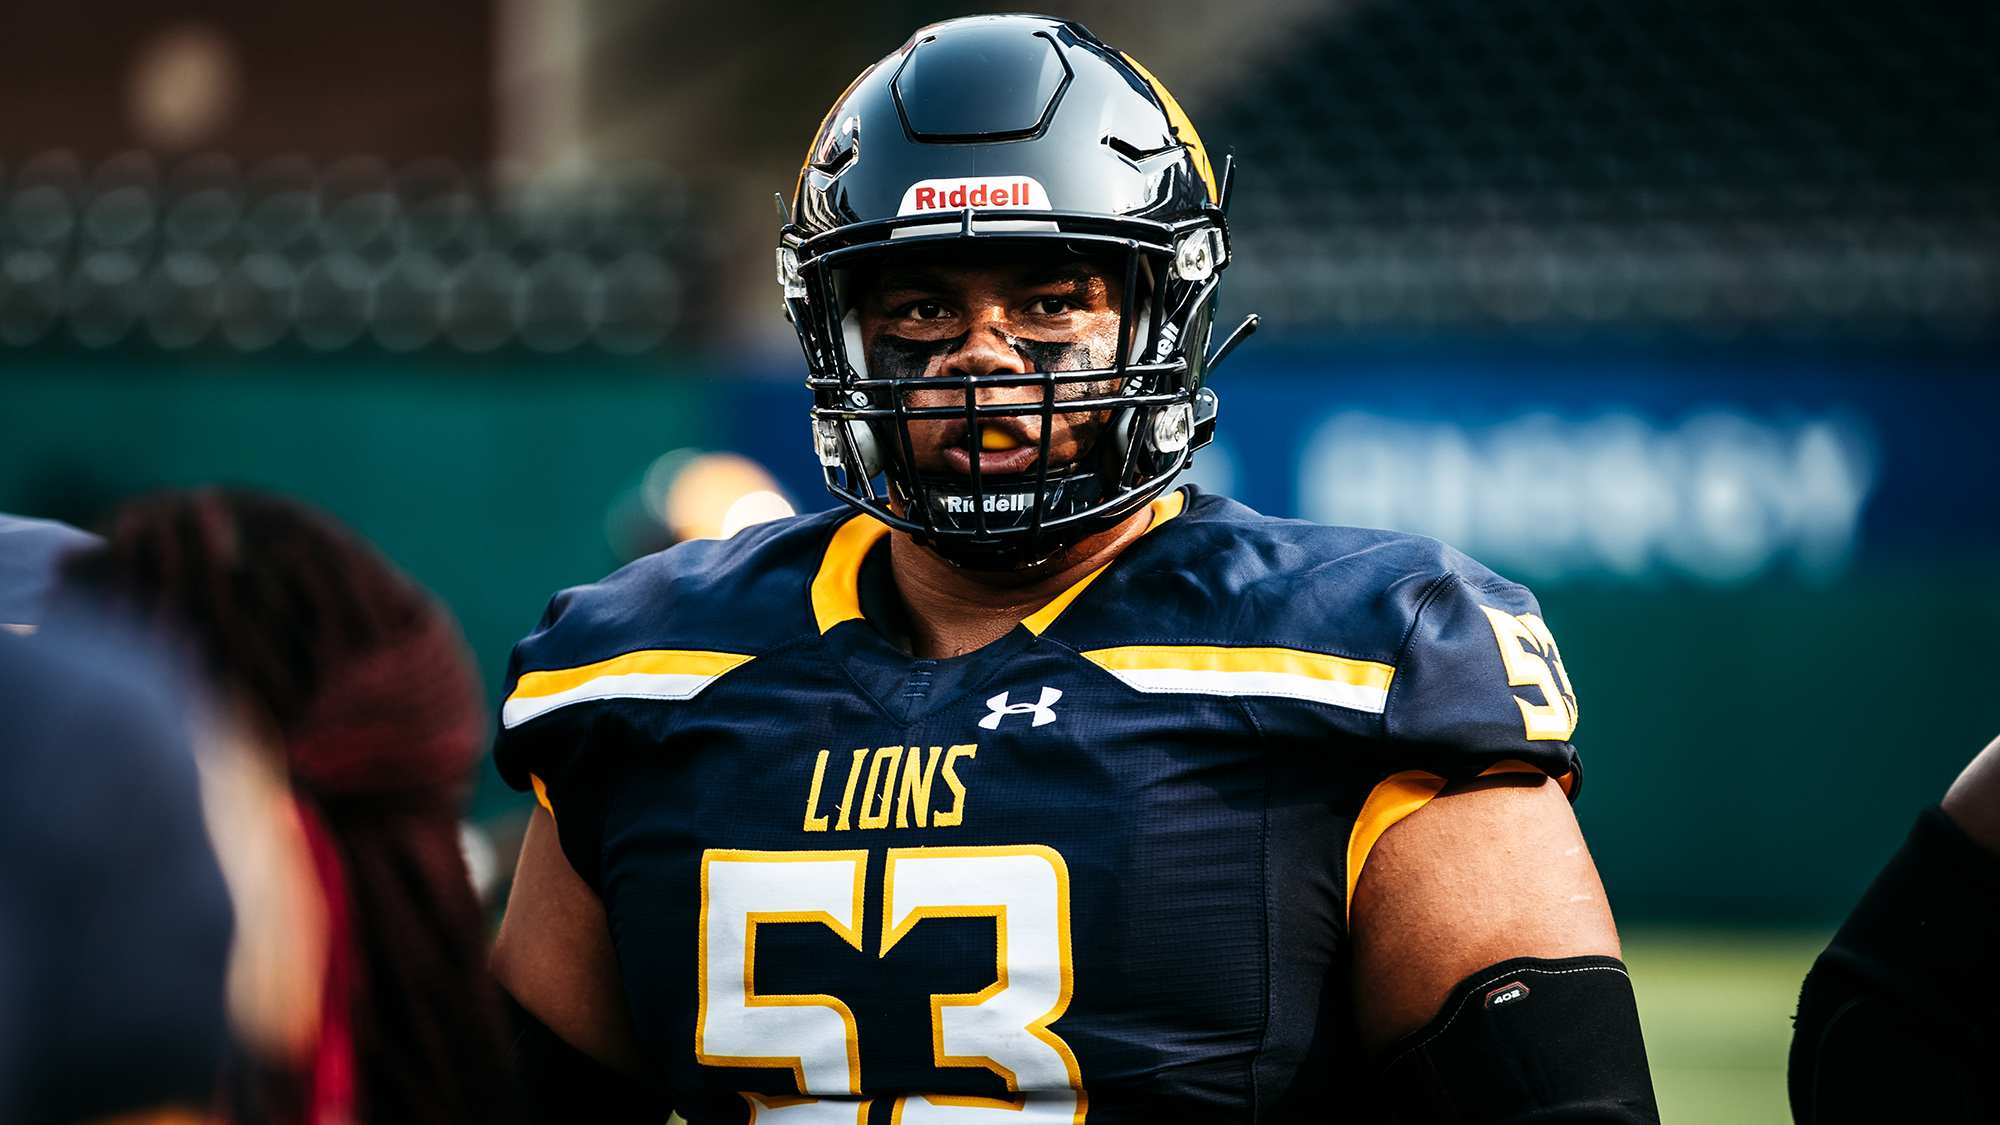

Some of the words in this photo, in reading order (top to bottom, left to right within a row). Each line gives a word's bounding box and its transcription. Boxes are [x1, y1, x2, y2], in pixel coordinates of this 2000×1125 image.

[915, 182, 1030, 211] Riddell
[1122, 321, 1180, 396] Riell
[1479, 604, 1578, 742] 53
[803, 743, 978, 832] LIONS
[695, 843, 1090, 1125] 53
[1494, 989, 1521, 1005] 402
